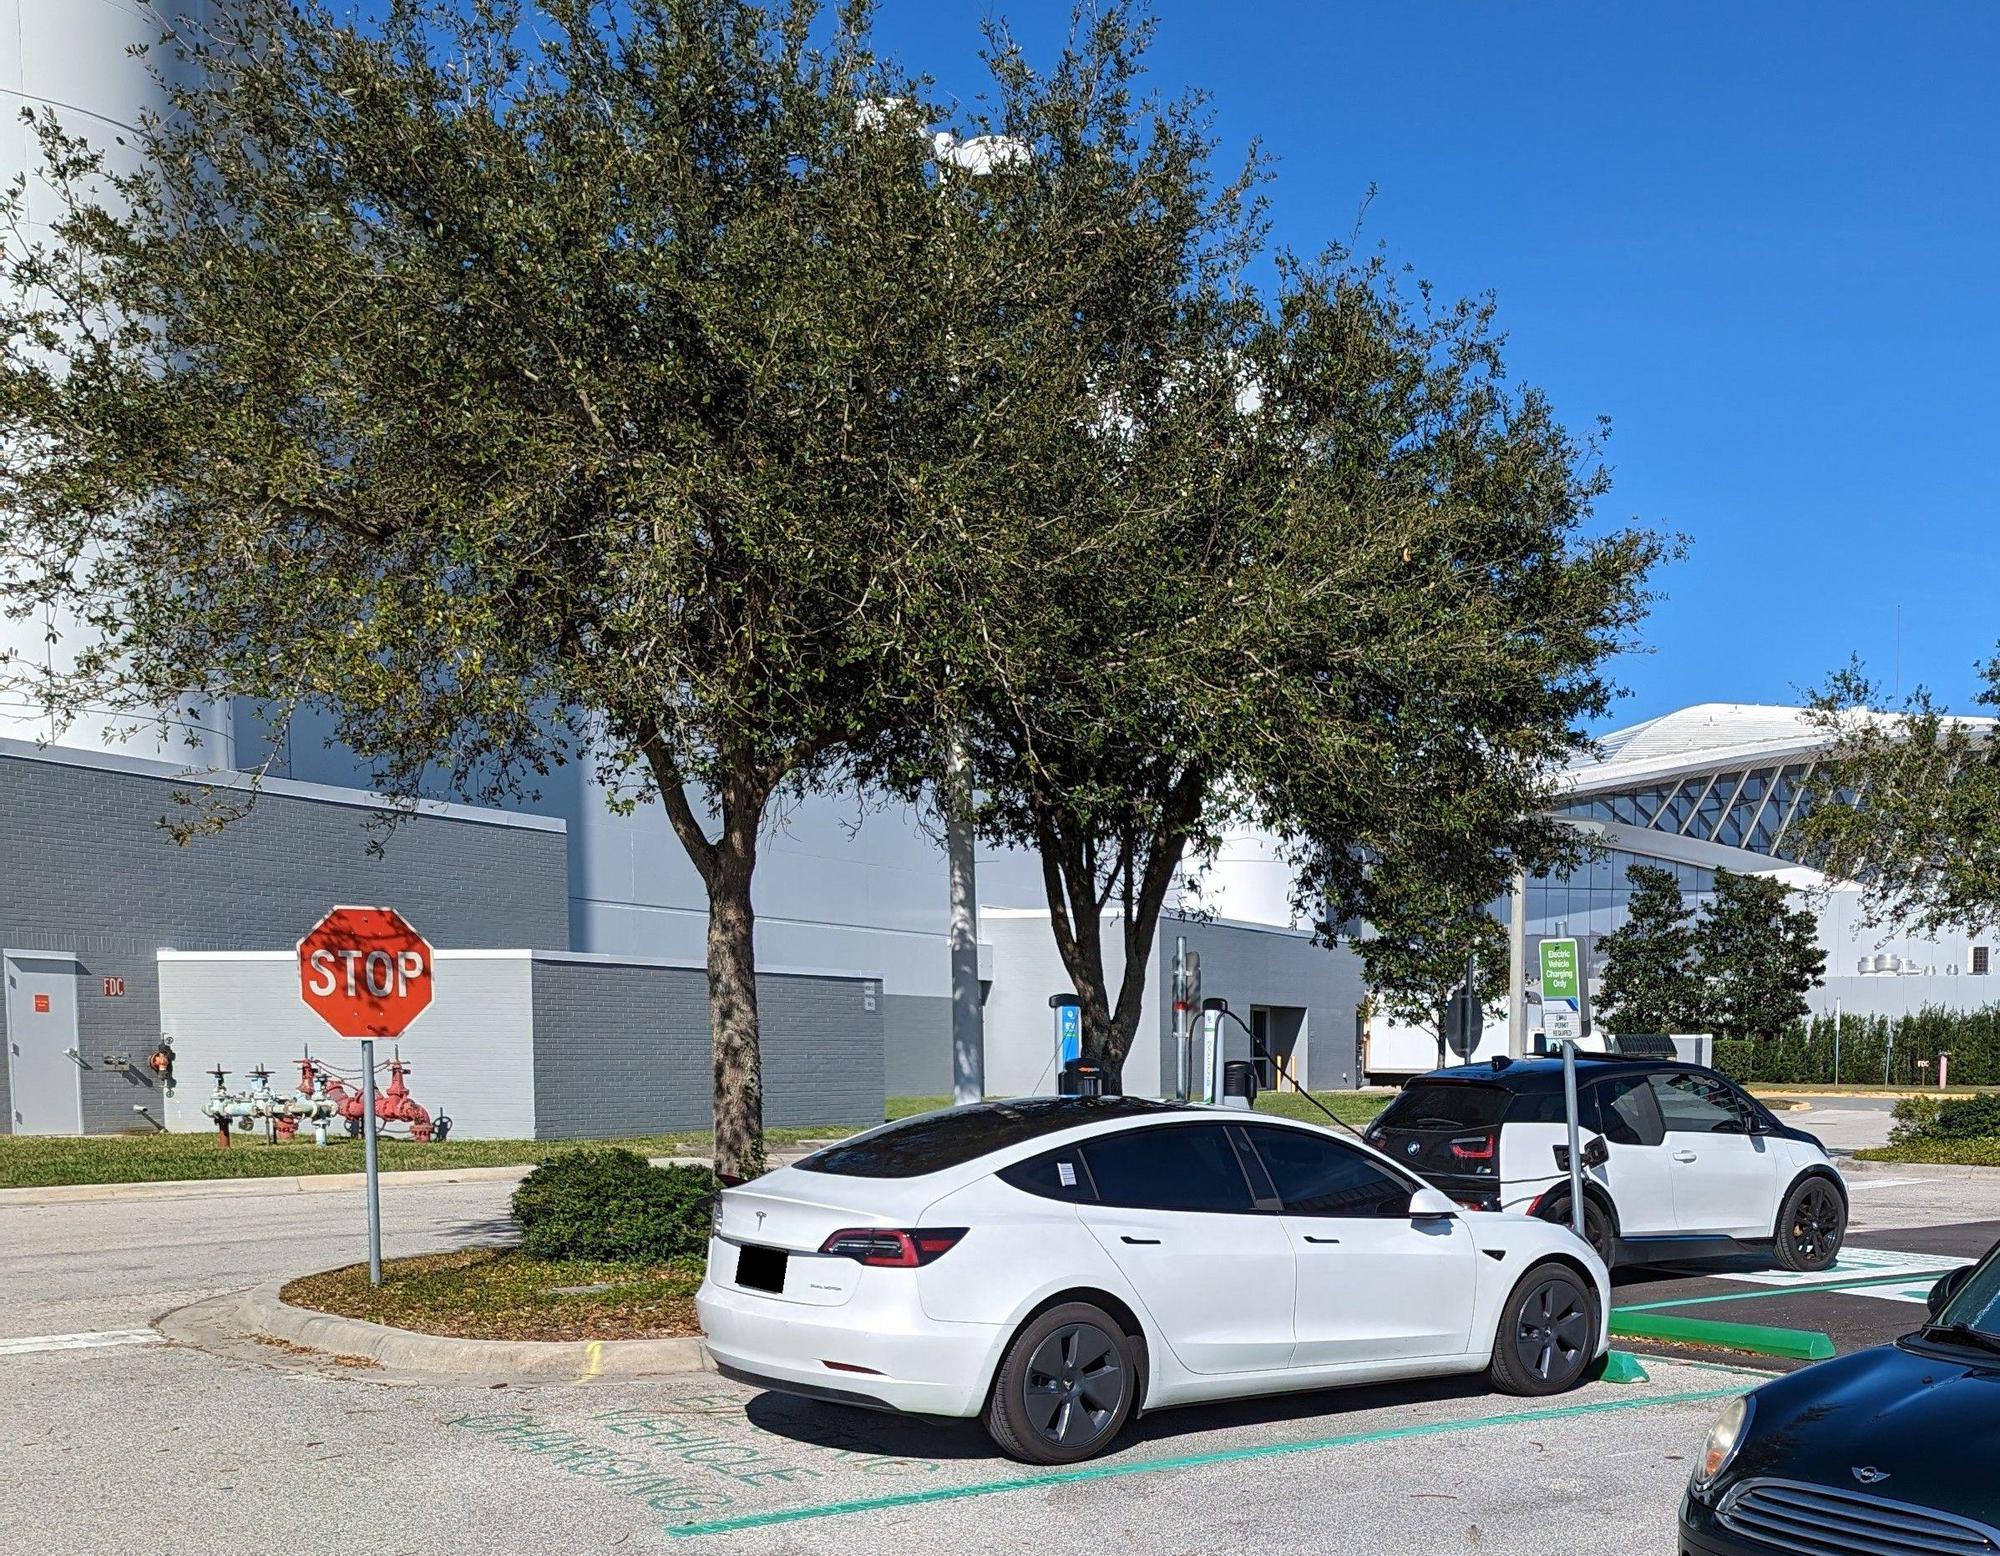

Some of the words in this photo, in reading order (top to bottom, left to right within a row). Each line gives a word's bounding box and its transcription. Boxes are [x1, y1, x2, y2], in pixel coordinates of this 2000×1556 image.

[1547, 950, 1571, 958] Electric
[1548, 960, 1570, 968] Vehicle
[309, 949, 424, 998] STOP
[1546, 970, 1573, 979] Charging
[103, 977, 124, 996] FDC
[1553, 979, 1567, 989] Only
[583, 1408, 823, 1488] VEHICLE
[457, 1413, 733, 1512] CHARGING
